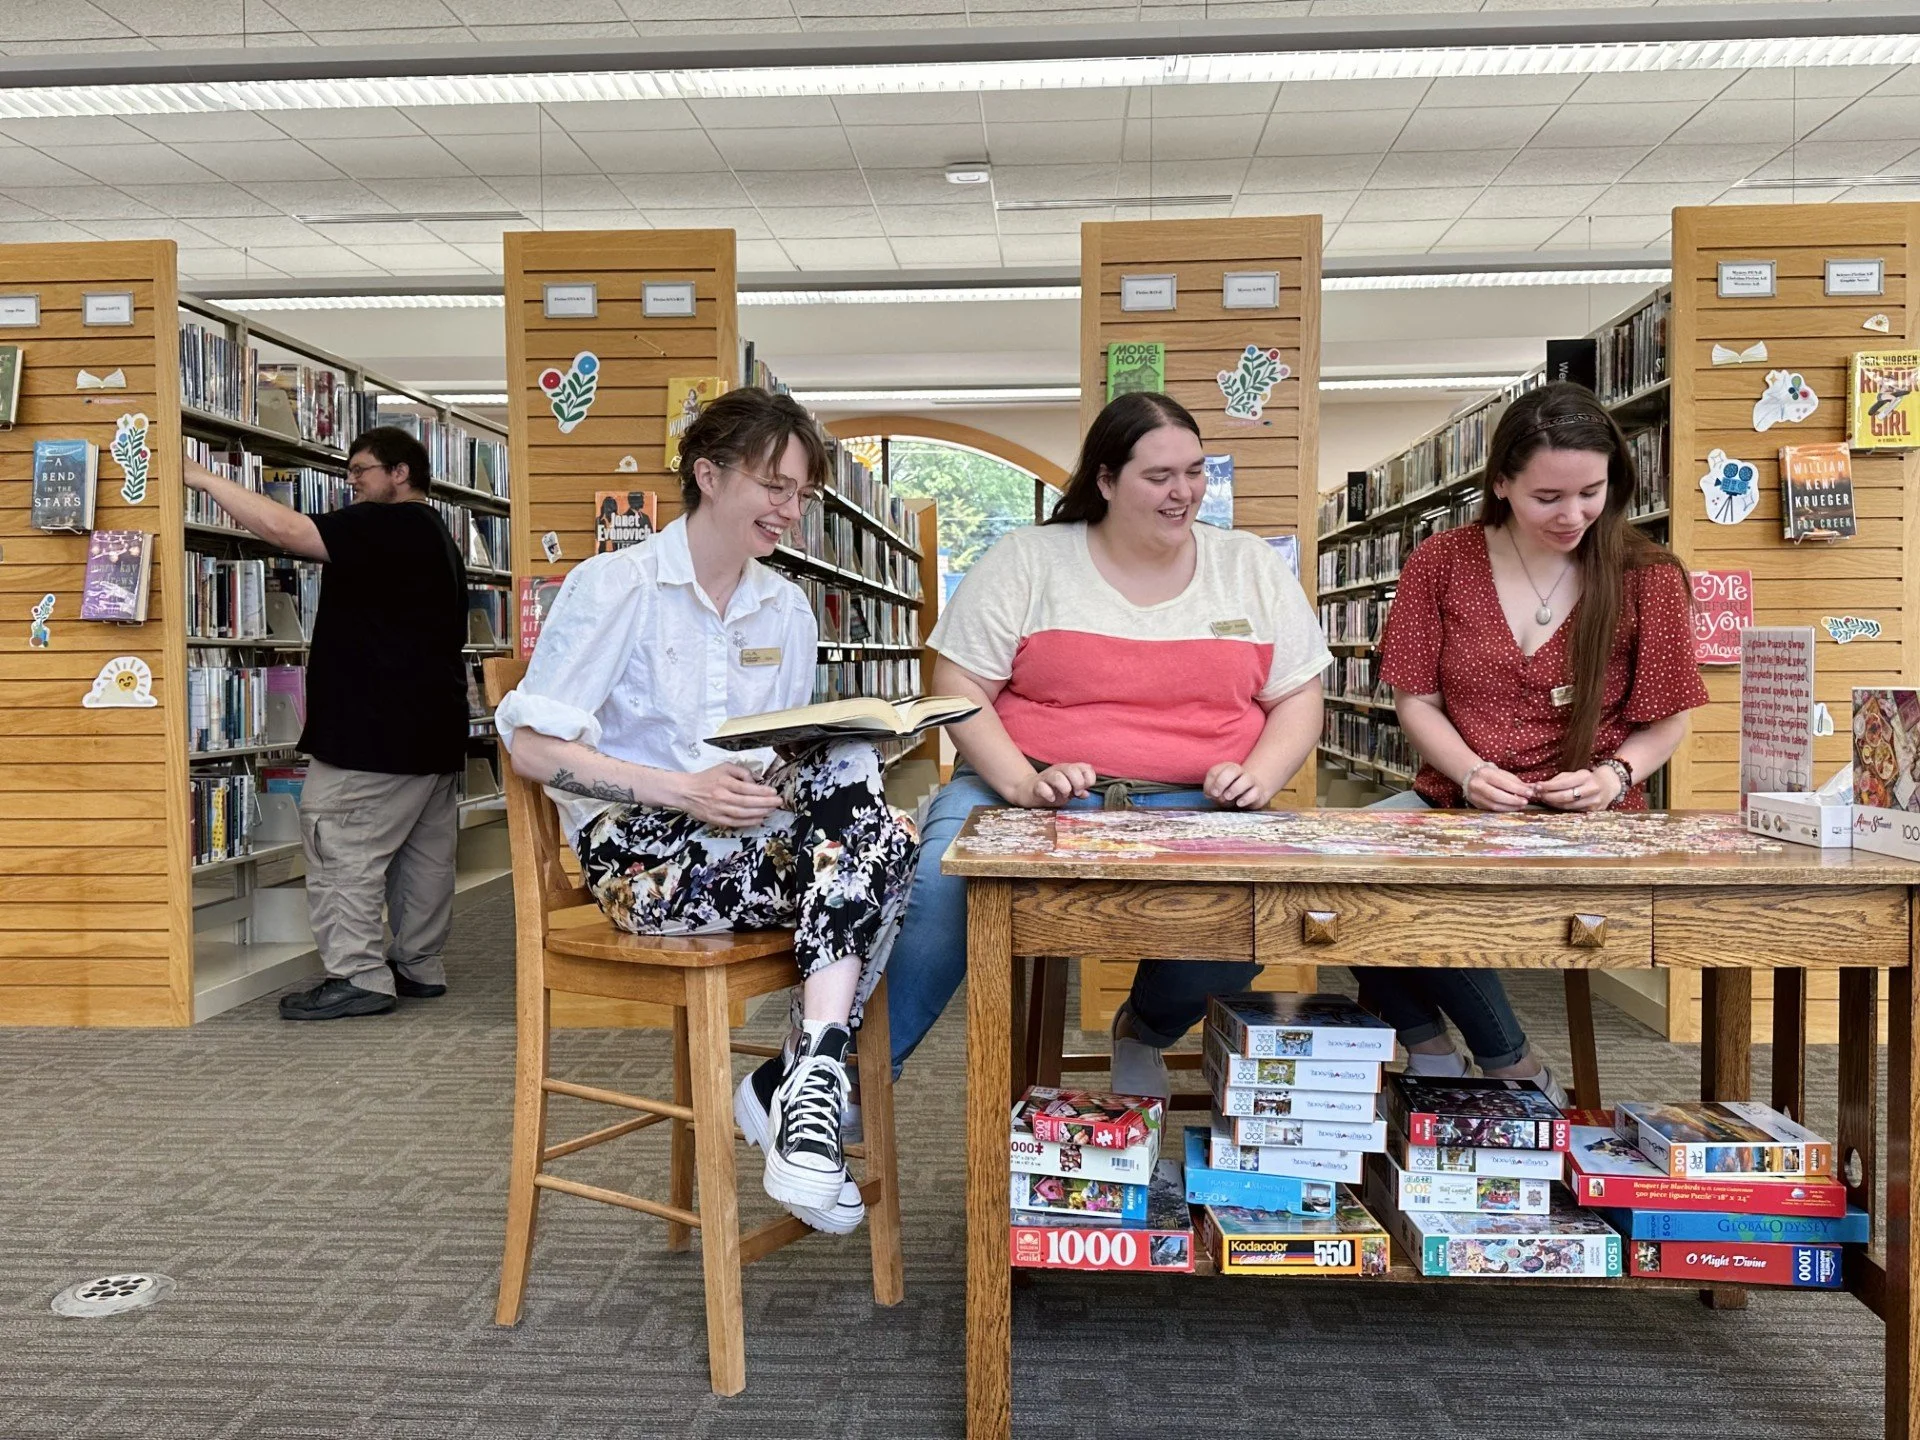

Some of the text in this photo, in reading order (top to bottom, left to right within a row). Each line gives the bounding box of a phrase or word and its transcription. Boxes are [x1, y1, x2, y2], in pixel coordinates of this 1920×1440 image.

[1113, 344, 1160, 356] MODEL
[1116, 355, 1156, 365] HOME
[1871, 410, 1911, 436] GIRL
[55, 458, 62, 466] A
[1794, 460, 1844, 474] WILLIAM
[42, 472, 75, 482] BEND
[1806, 477, 1836, 490] KENT
[34, 498, 81, 508] STARS
[1795, 493, 1850, 508] KRUEGER
[610, 512, 640, 528] Janet
[1797, 518, 1851, 530] FOX CREEK
[598, 524, 651, 542] Evanovich
[120, 561, 138, 576] kay
[1693, 574, 1748, 602] Me
[522, 590, 540, 600] ALL
[522, 604, 542, 616] HER
[1694, 611, 1749, 640] You
[1748, 640, 1805, 651] Jigsaw Puzzle Swap
[1776, 656, 1791, 666] Bring
[1793, 658, 1806, 666] your
[1774, 672, 1804, 682] pre-owned
[1761, 686, 1771, 694] and
[1773, 688, 1788, 697] swap
[1790, 688, 1804, 697] with
[1774, 703, 1781, 711] to
[1782, 704, 1795, 714] you,
[1797, 705, 1808, 714] and
[1778, 720, 1808, 730] complete
[1752, 732, 1770, 741] puzzle
[1781, 734, 1791, 743] the
[1792, 736, 1808, 746] table
[1902, 824, 1920, 841] 100
[1256, 1044, 1274, 1052] 300
[1238, 1072, 1256, 1080] 300
[1234, 1103, 1252, 1111] 300
[1036, 1119, 1045, 1140] 500
[1245, 1132, 1264, 1140] 300
[1555, 1124, 1566, 1147] 500
[1219, 1157, 1238, 1165] 300
[1416, 1158, 1434, 1167] 300
[1674, 1149, 1686, 1172] 300
[1404, 1184, 1432, 1194] 300
[1634, 1182, 1660, 1190] Bouquet
[1660, 1182, 1670, 1190] for
[1195, 1192, 1219, 1202] 550
[1046, 1230, 1137, 1266] 1000
[1231, 1241, 1288, 1252] Kodacolor
[1016, 1253, 1041, 1262] Guild
[1314, 1240, 1352, 1266] 550
[1607, 1242, 1618, 1270] 1500
[1686, 1253, 1767, 1268] O Night Divine
[1798, 1249, 1811, 1281] 1000
